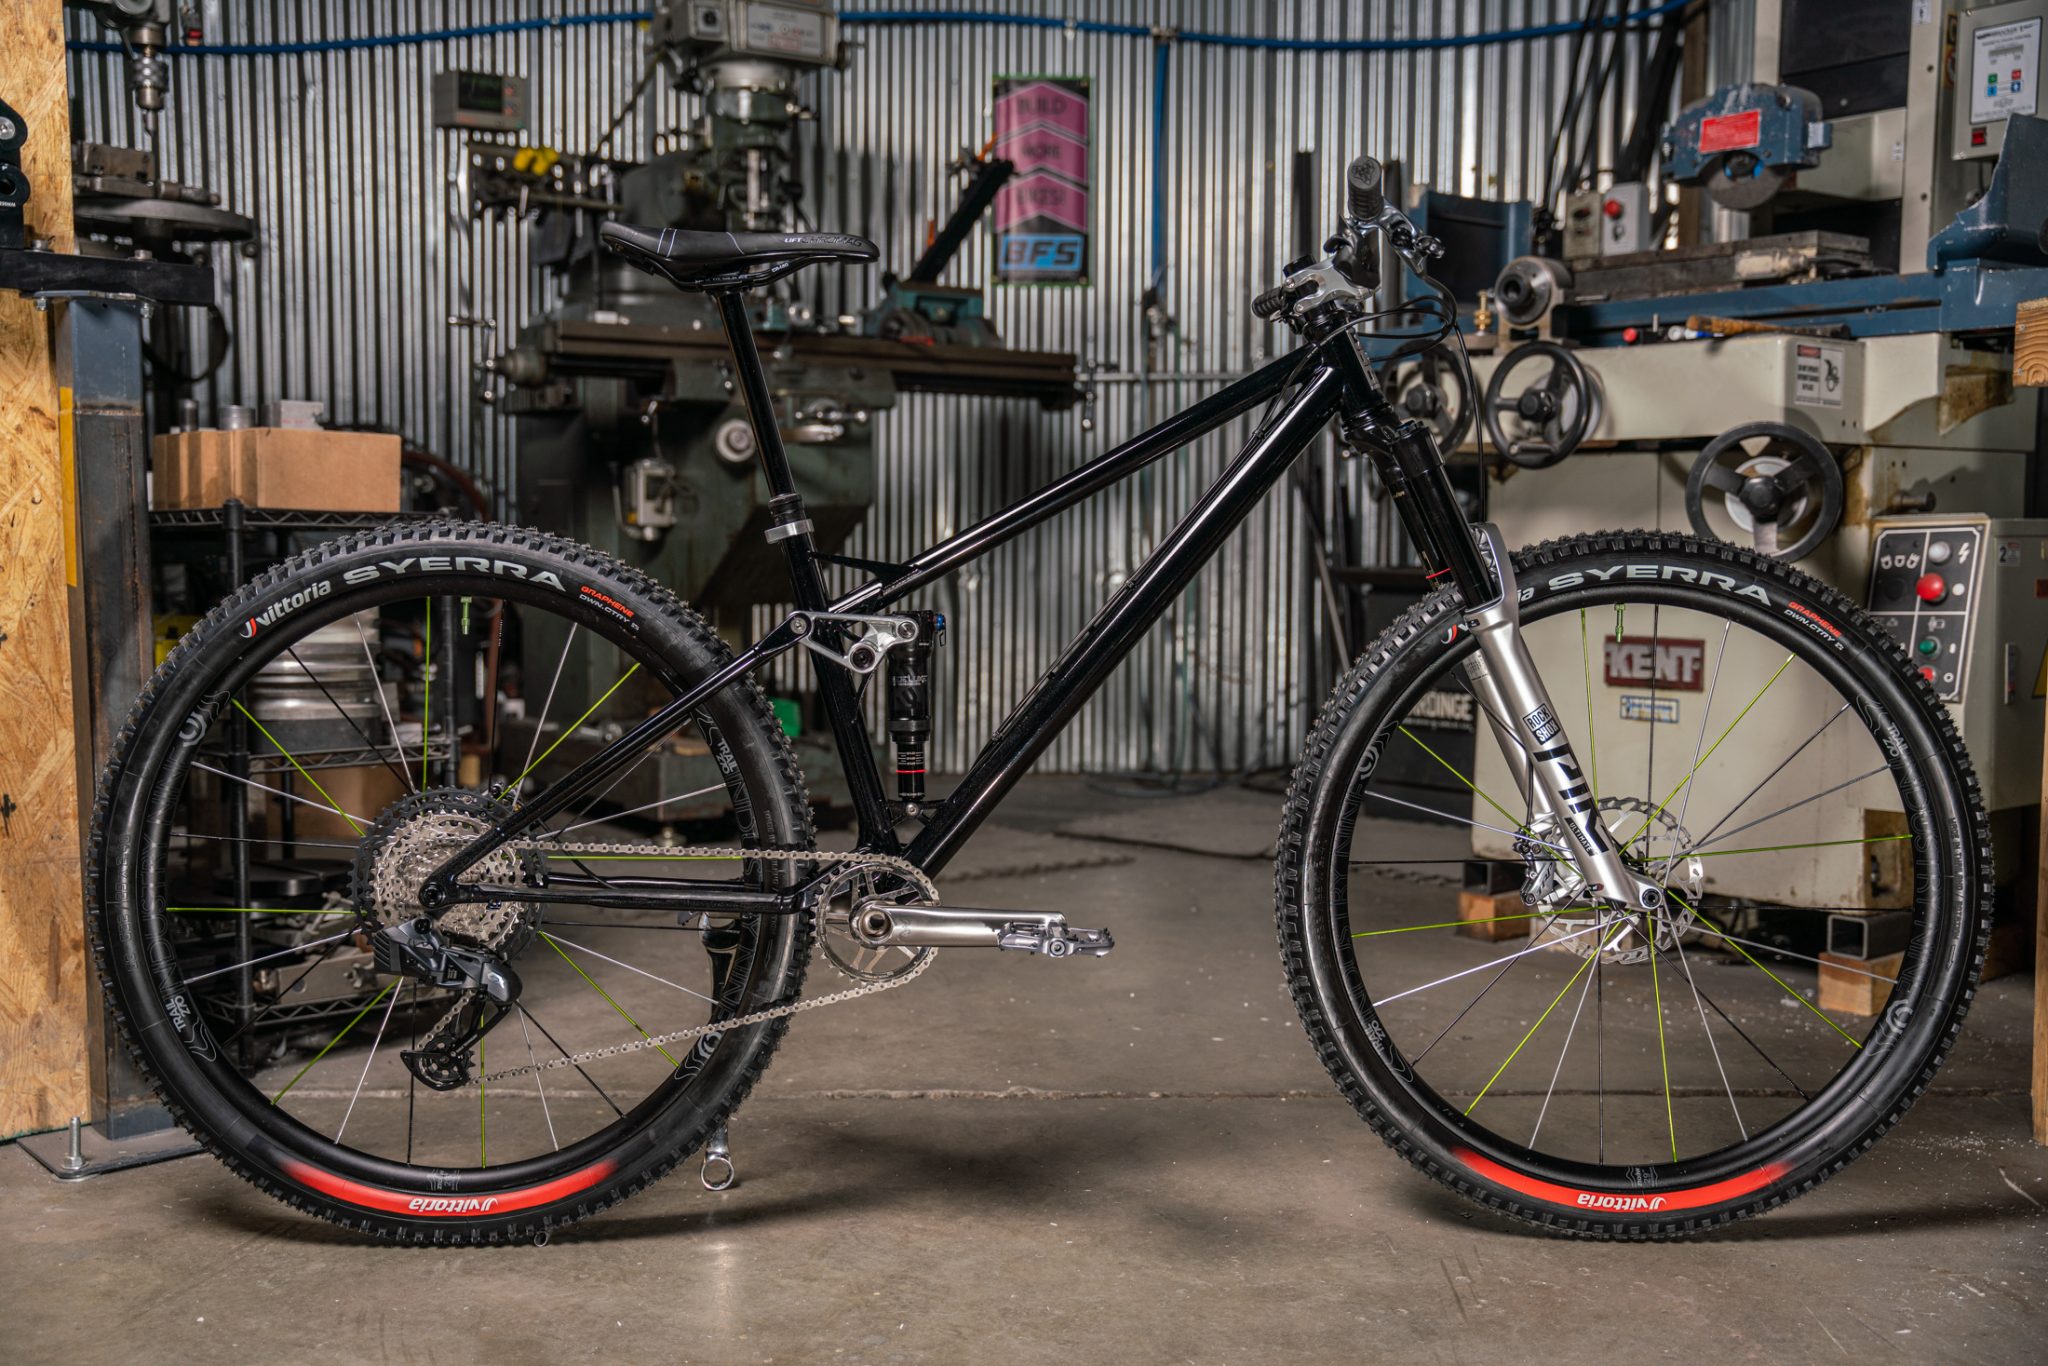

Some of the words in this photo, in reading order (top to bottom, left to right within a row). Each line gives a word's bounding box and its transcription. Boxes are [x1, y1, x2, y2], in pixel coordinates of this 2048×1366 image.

[1006, 240, 1081, 266] BFS
[256, 580, 332, 627] vittoria
[342, 556, 567, 592] SYERRA
[580, 585, 635, 618] GRAPHENE
[1548, 564, 1772, 607] SYERRA
[1788, 601, 1842, 638] GRAPHENE
[1604, 642, 1701, 683] KENT
[1526, 706, 1552, 730] ROCK
[1535, 719, 1560, 743] SHOX
[1887, 721, 1909, 754] TRAIL
[717, 738, 738, 773] TRAIL
[1569, 822, 1592, 852] ULTIMATE
[165, 998, 186, 1033] TRAIL
[1364, 1022, 1385, 1052] TRAIL
[408, 1198, 480, 1213] vittoria
[1577, 1193, 1649, 1211] vittoria
